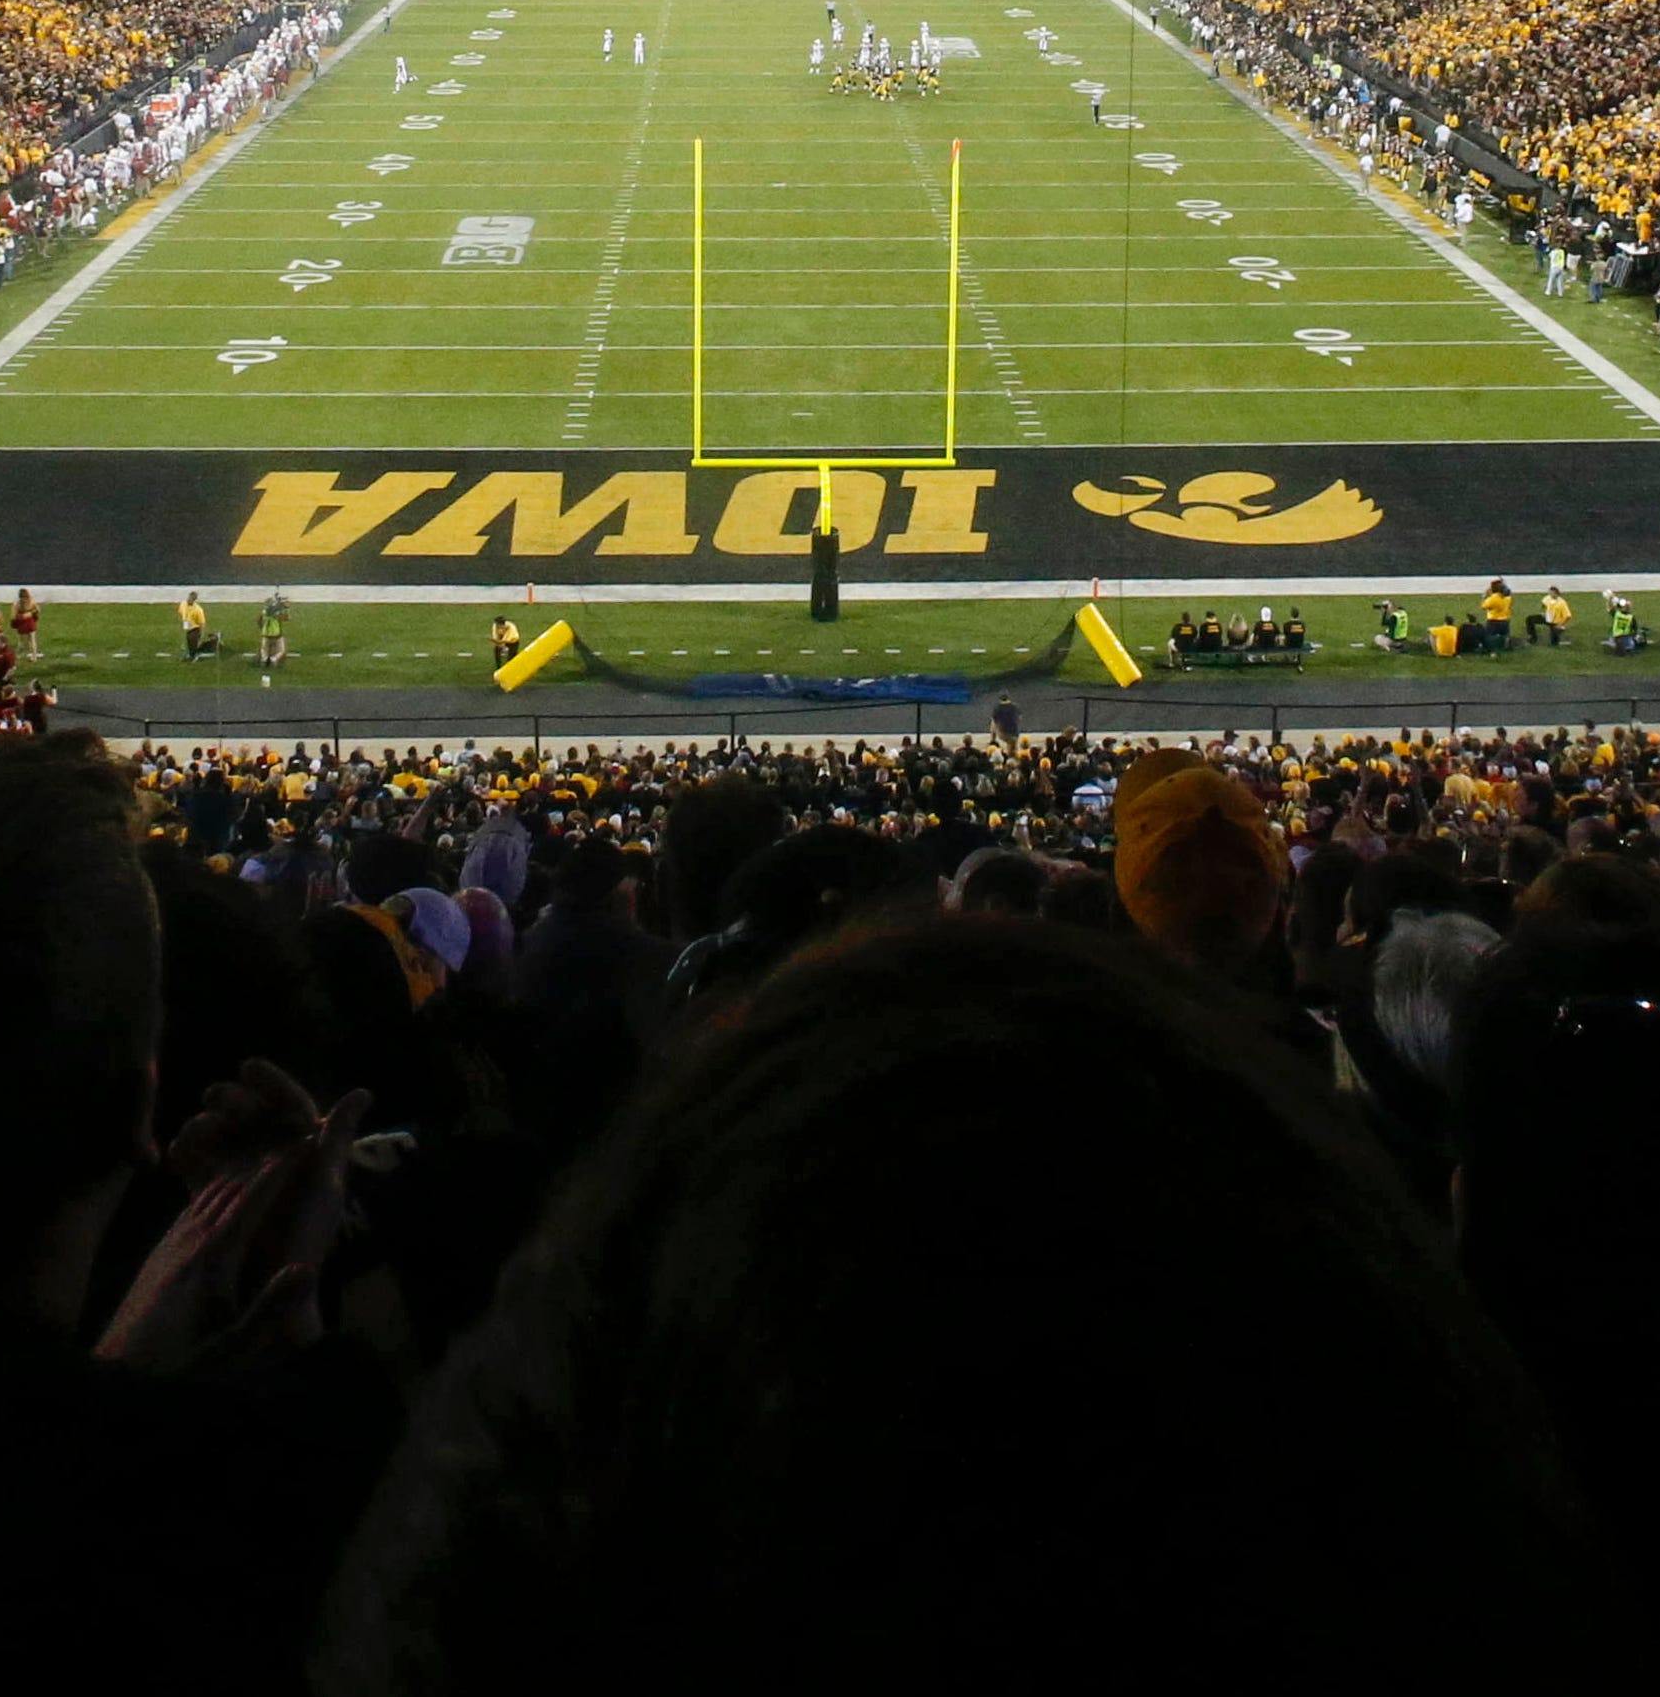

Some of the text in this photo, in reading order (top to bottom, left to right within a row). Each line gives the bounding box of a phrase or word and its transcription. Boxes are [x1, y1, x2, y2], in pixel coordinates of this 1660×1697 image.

[399, 115, 444, 129] 50
[1098, 115, 1145, 129] 50
[367, 153, 416, 171] 40
[1133, 153, 1184, 170] 40
[327, 201, 383, 222] 30
[1176, 199, 1233, 220] 30
[278, 259, 343, 284] 20
[1228, 256, 1297, 282] 20
[216, 335, 288, 364] 10
[1293, 328, 1365, 356] 10
[229, 469, 998, 557] IOWA
